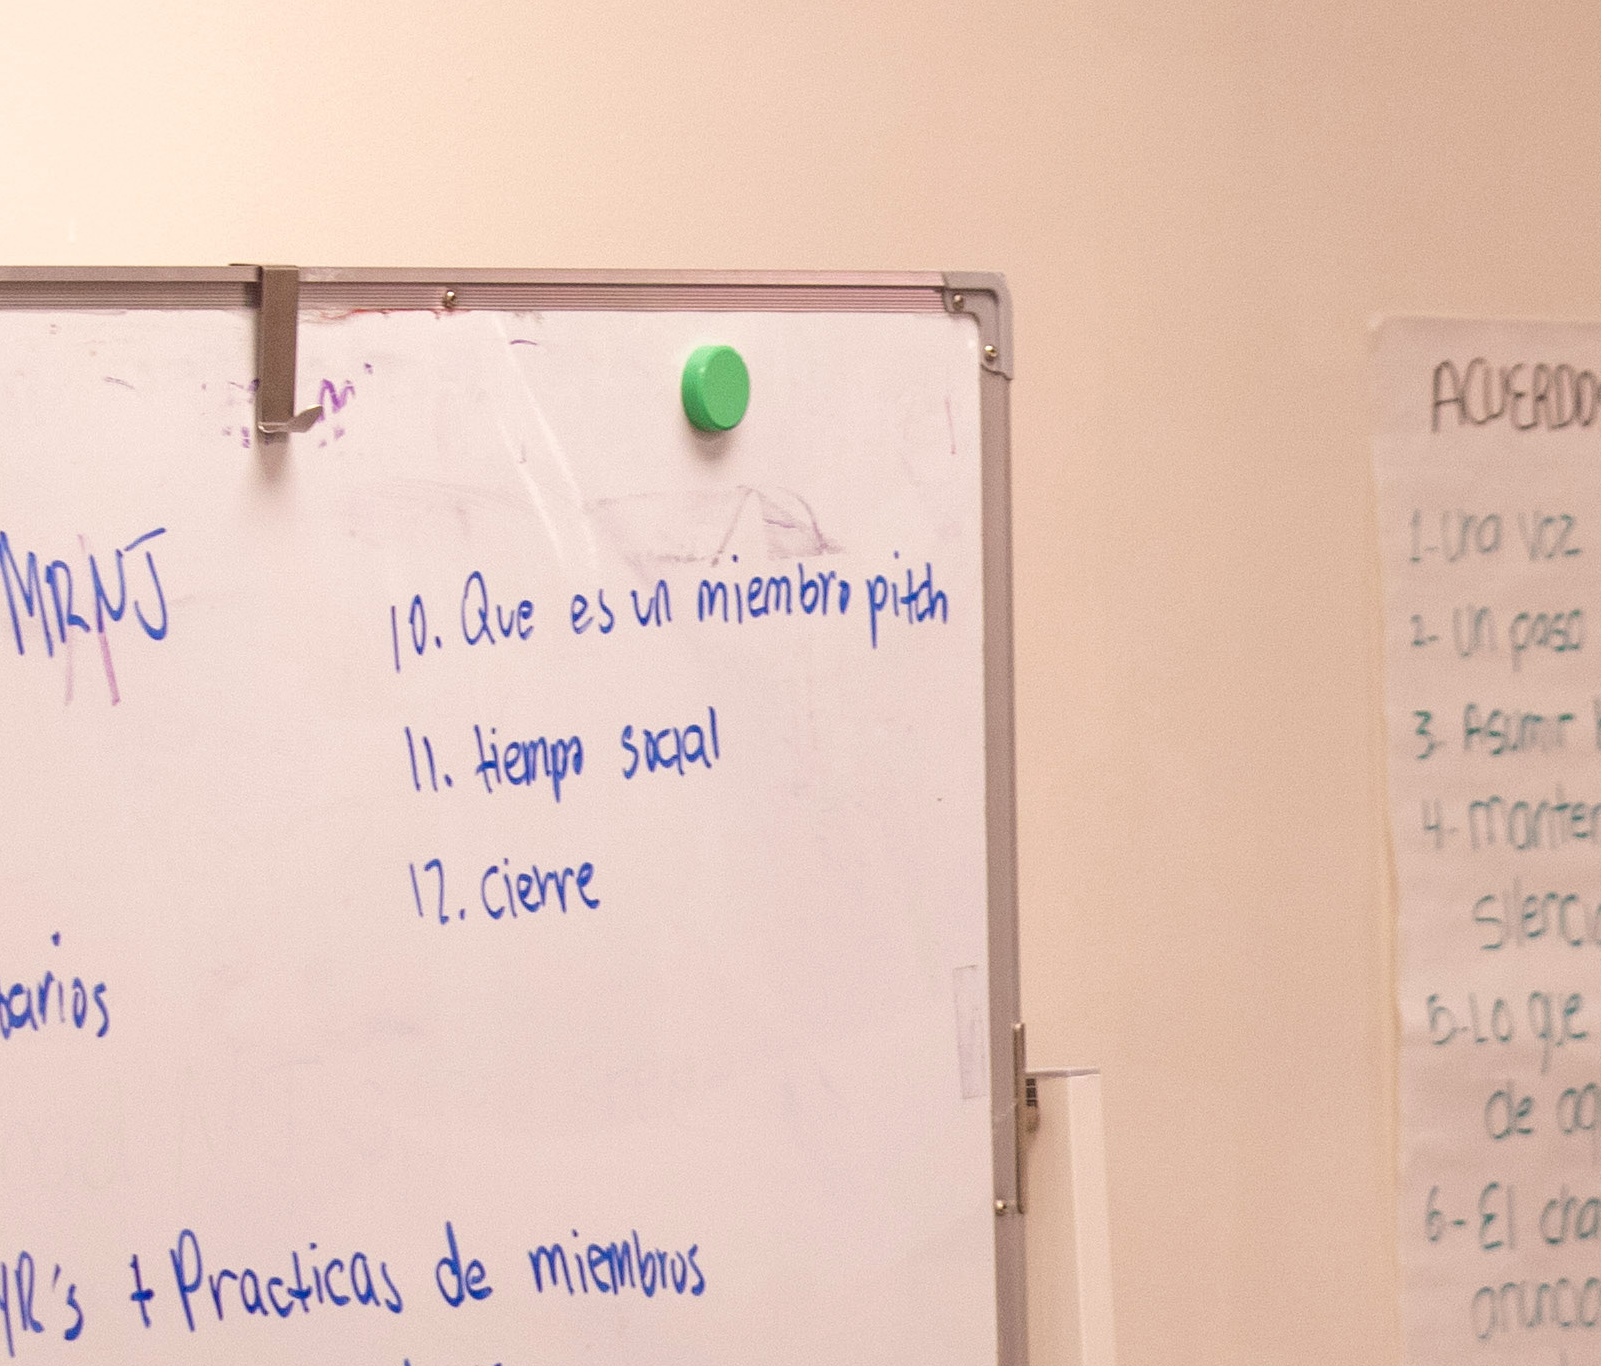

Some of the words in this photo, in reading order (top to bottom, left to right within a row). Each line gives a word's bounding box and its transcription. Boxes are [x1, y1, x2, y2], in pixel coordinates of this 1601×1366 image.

[461, 570, 535, 646] Que
[570, 588, 615, 635] es
[630, 579, 672, 628] un
[697, 554, 852, 626] miembro
[621, 706, 721, 780] social
[168, 1227, 405, 1332] Practicas
[434, 1221, 495, 1309] de
[526, 1228, 707, 1298] miembros
